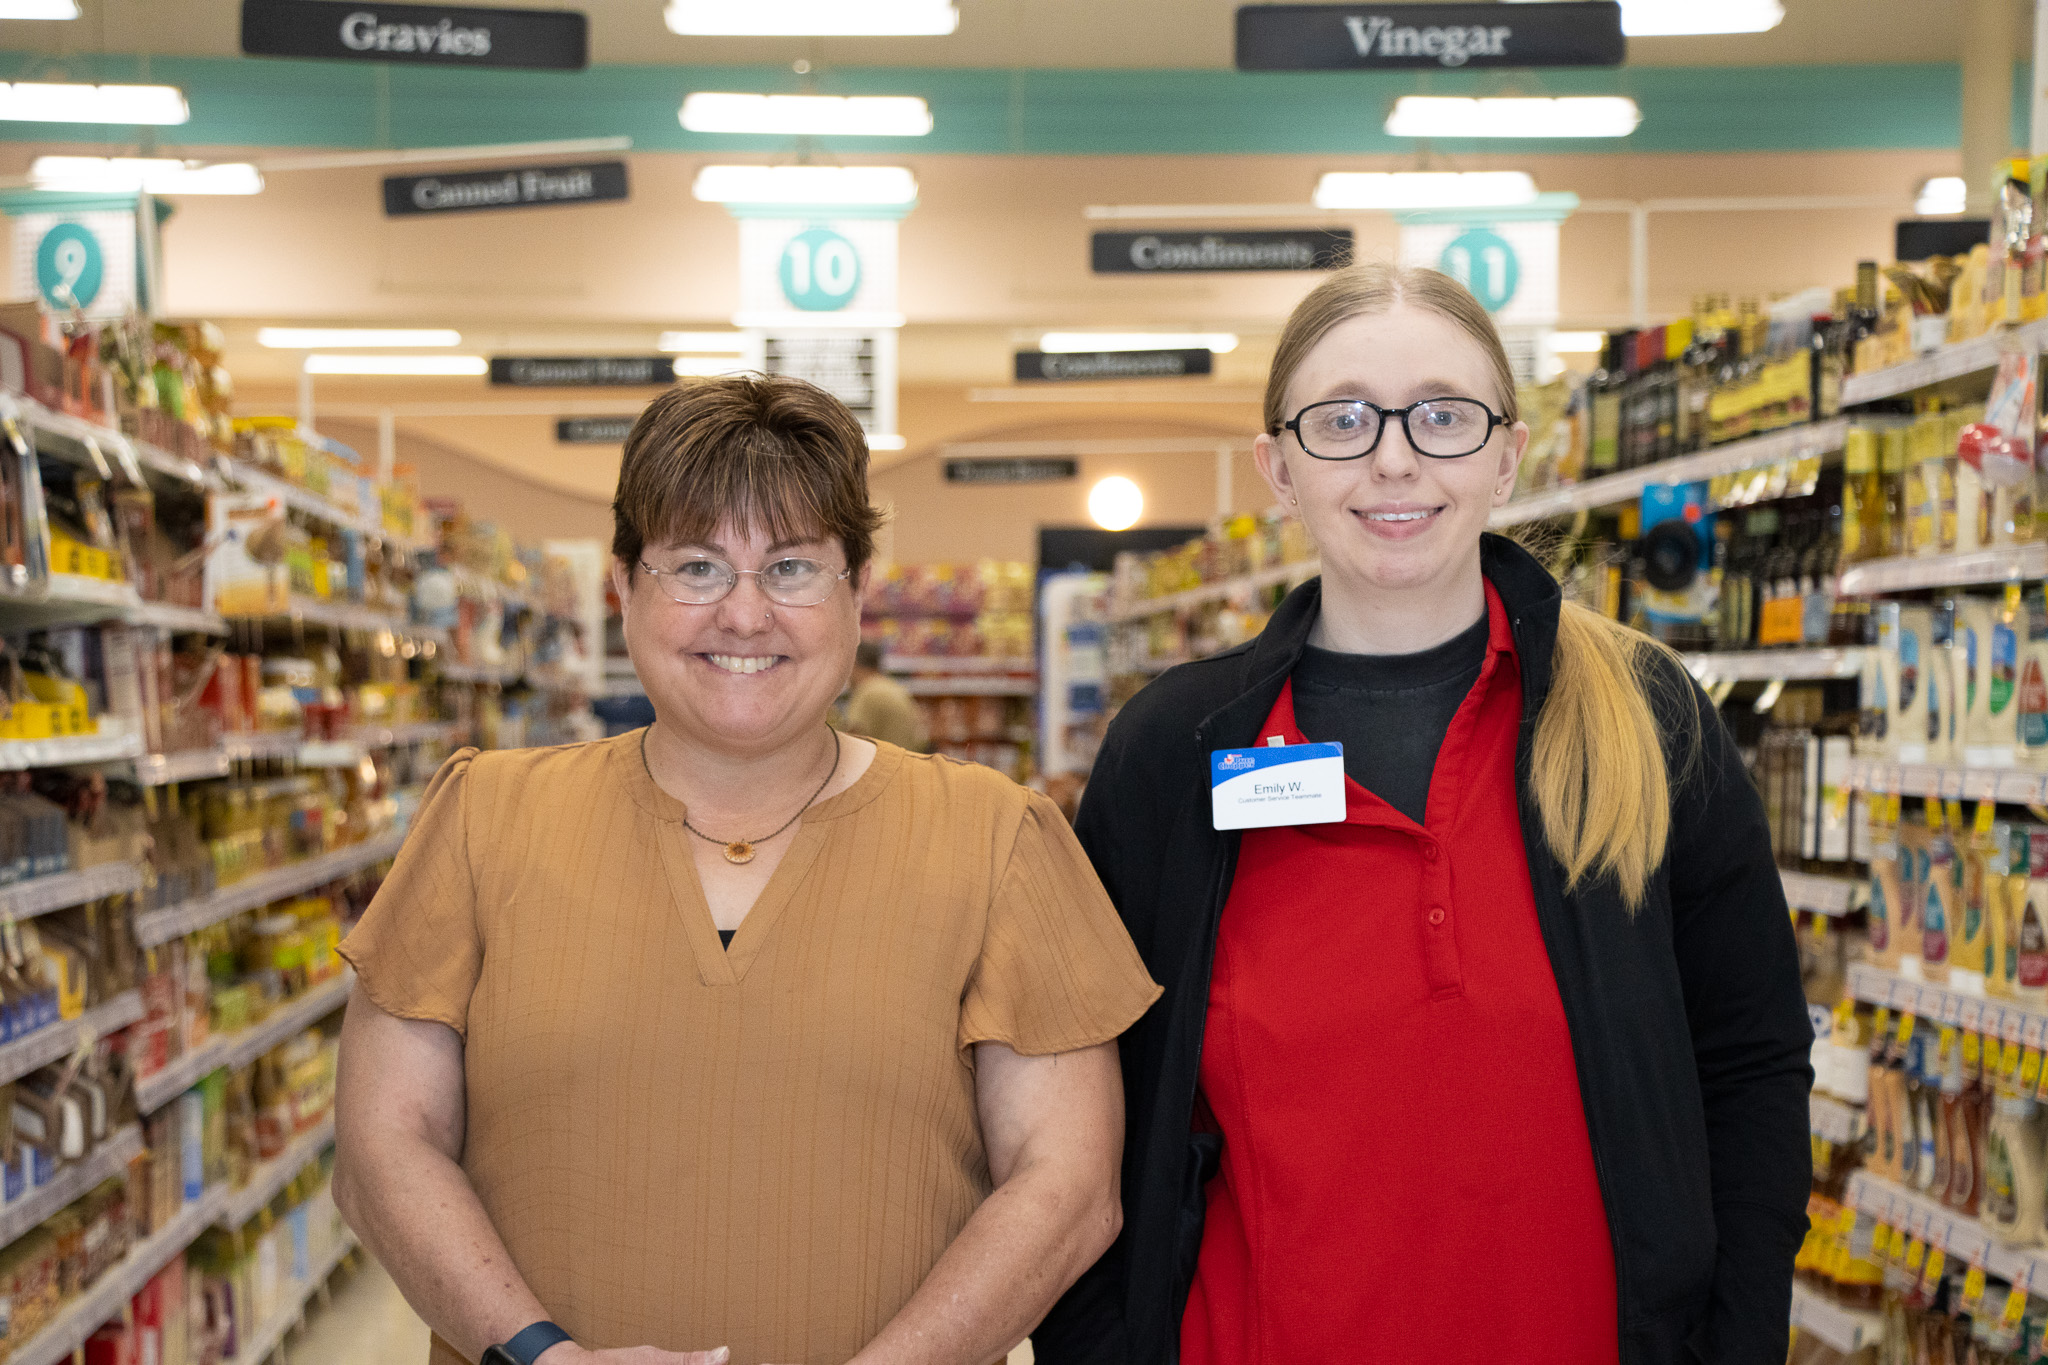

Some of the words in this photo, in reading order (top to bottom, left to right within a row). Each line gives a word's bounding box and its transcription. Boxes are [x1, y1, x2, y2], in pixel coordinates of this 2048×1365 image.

[340, 12, 492, 56] Gravies
[1344, 15, 1512, 67] Vinegar
[412, 176, 518, 210] Canned
[521, 168, 593, 200] Fruit
[54, 238, 87, 300] 9
[787, 239, 858, 297] 10
[1130, 235, 1313, 270] Condiments
[1450, 246, 1507, 301] 11
[1254, 783, 1286, 795] Emily
